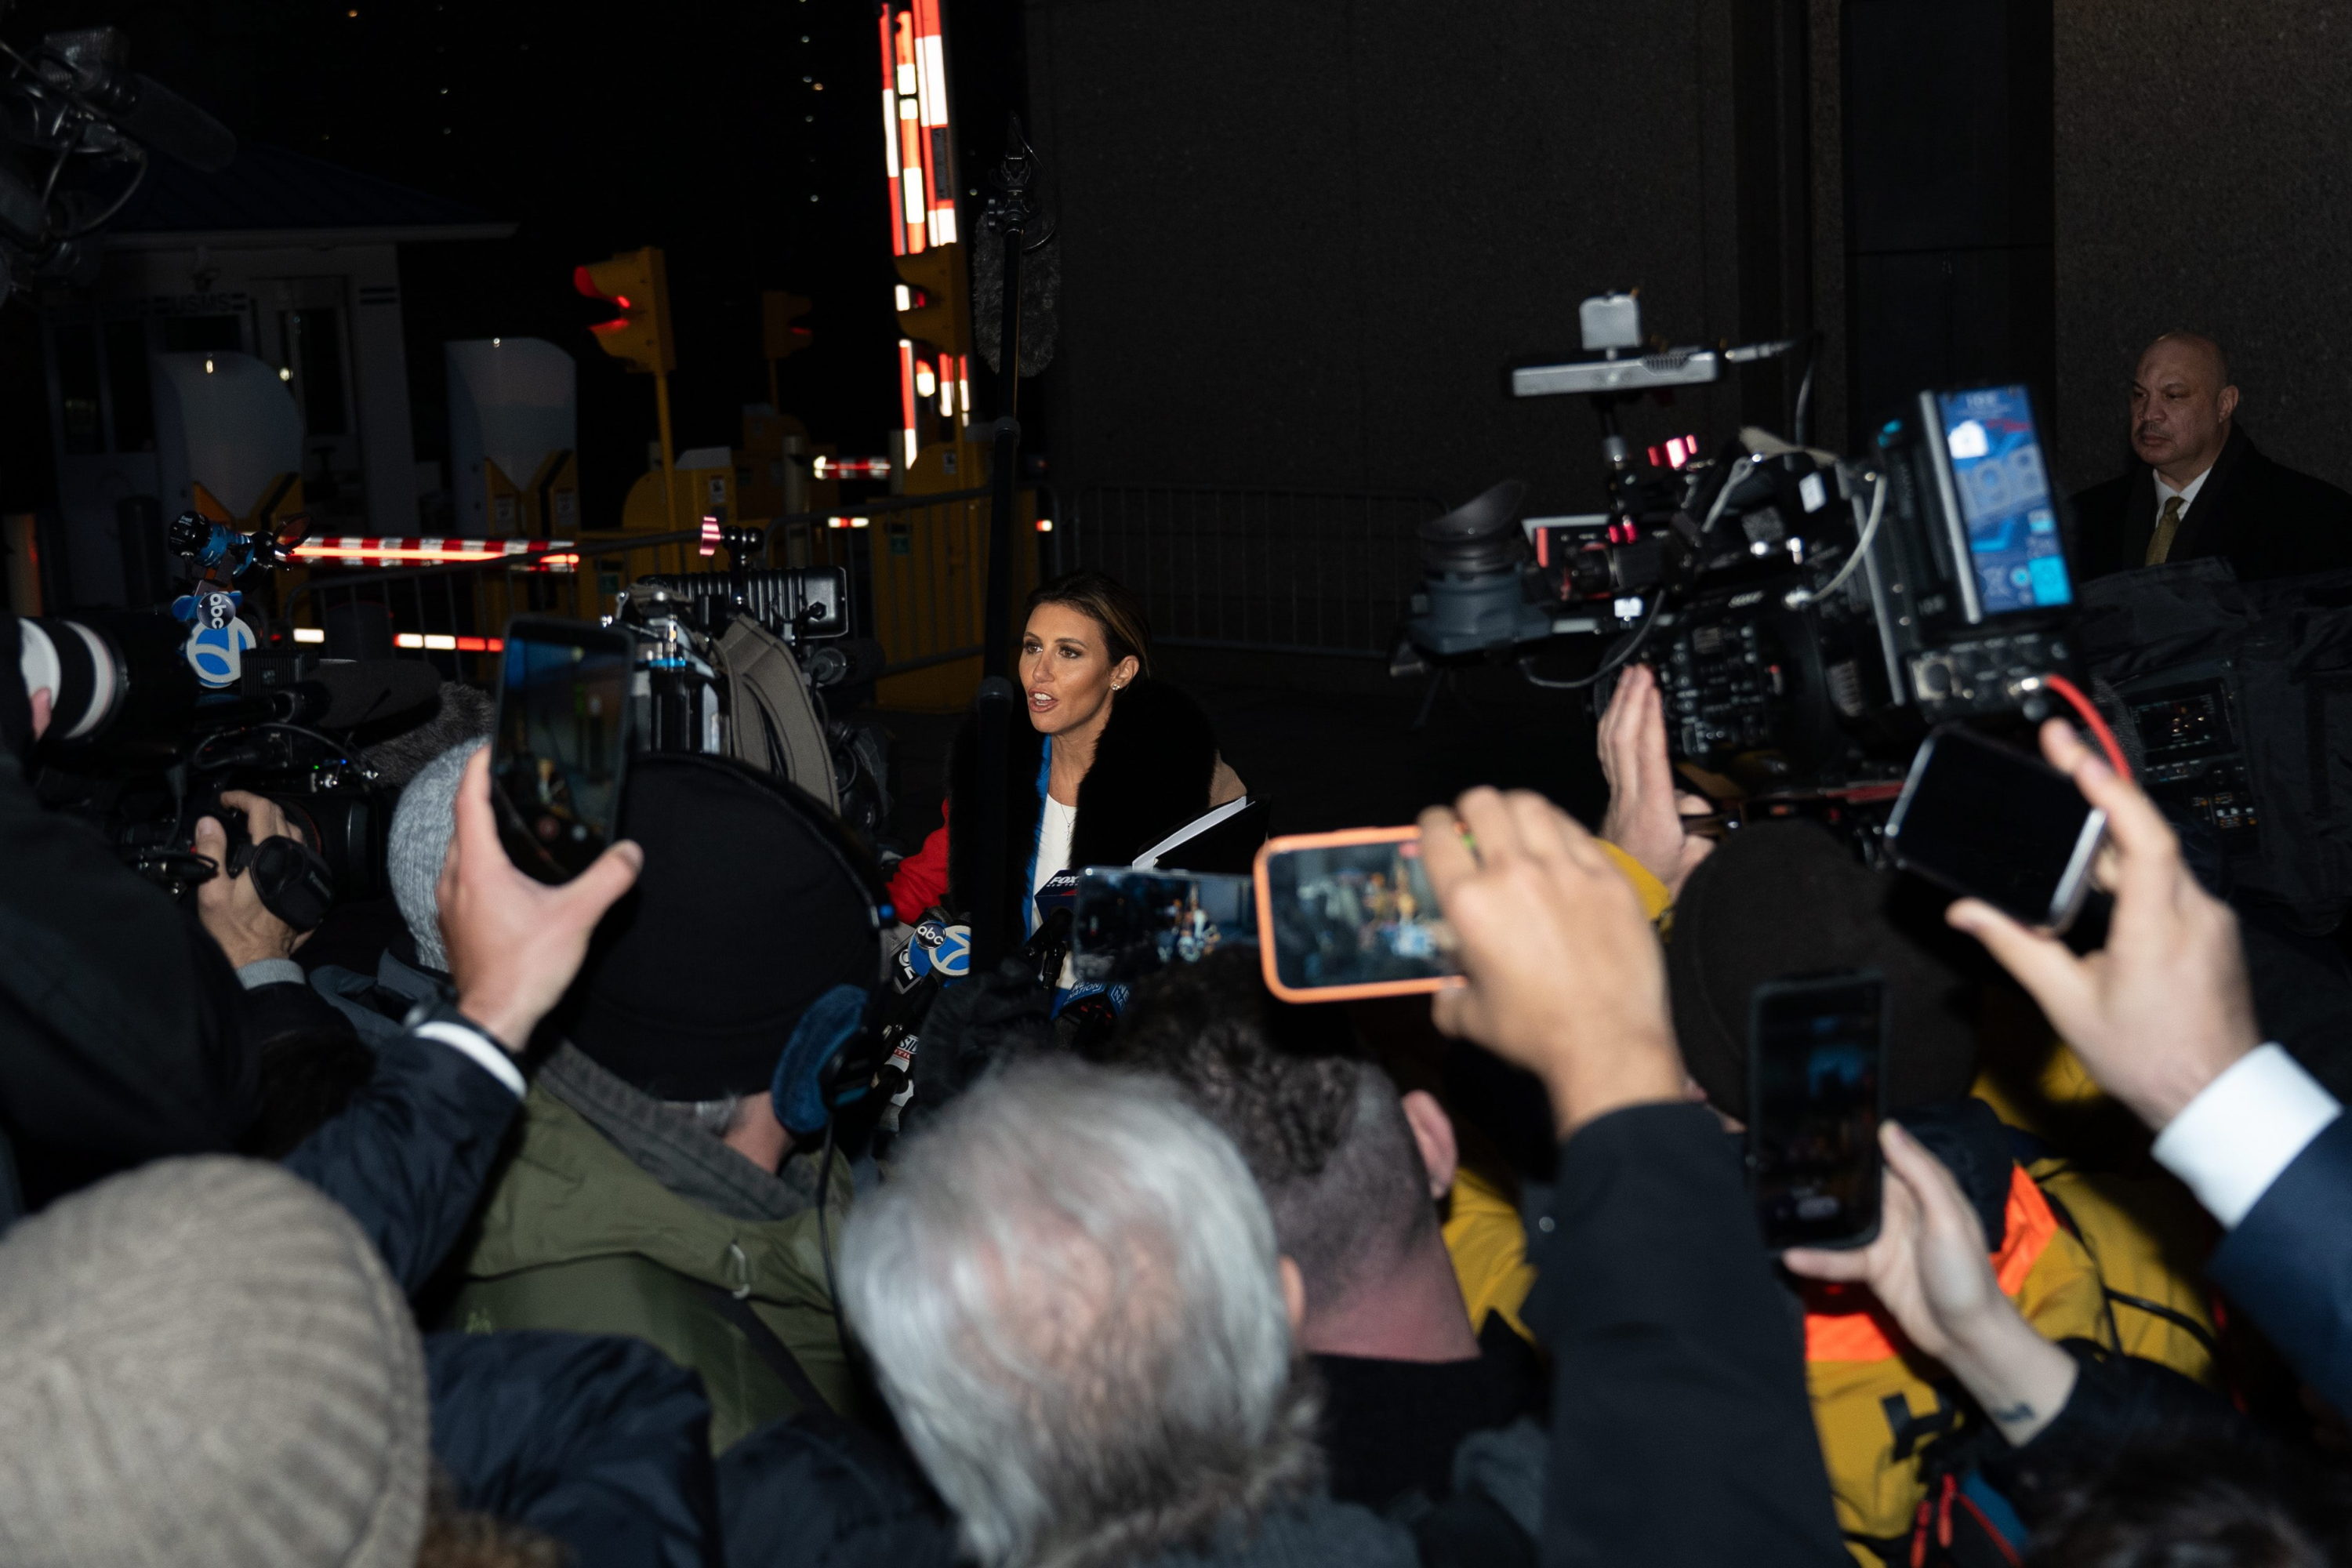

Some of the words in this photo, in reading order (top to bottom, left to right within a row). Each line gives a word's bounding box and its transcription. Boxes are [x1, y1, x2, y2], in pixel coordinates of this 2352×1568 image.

[210, 593, 227, 629] abc
[1049, 876, 1079, 884] FOX
[917, 925, 943, 945] abc
